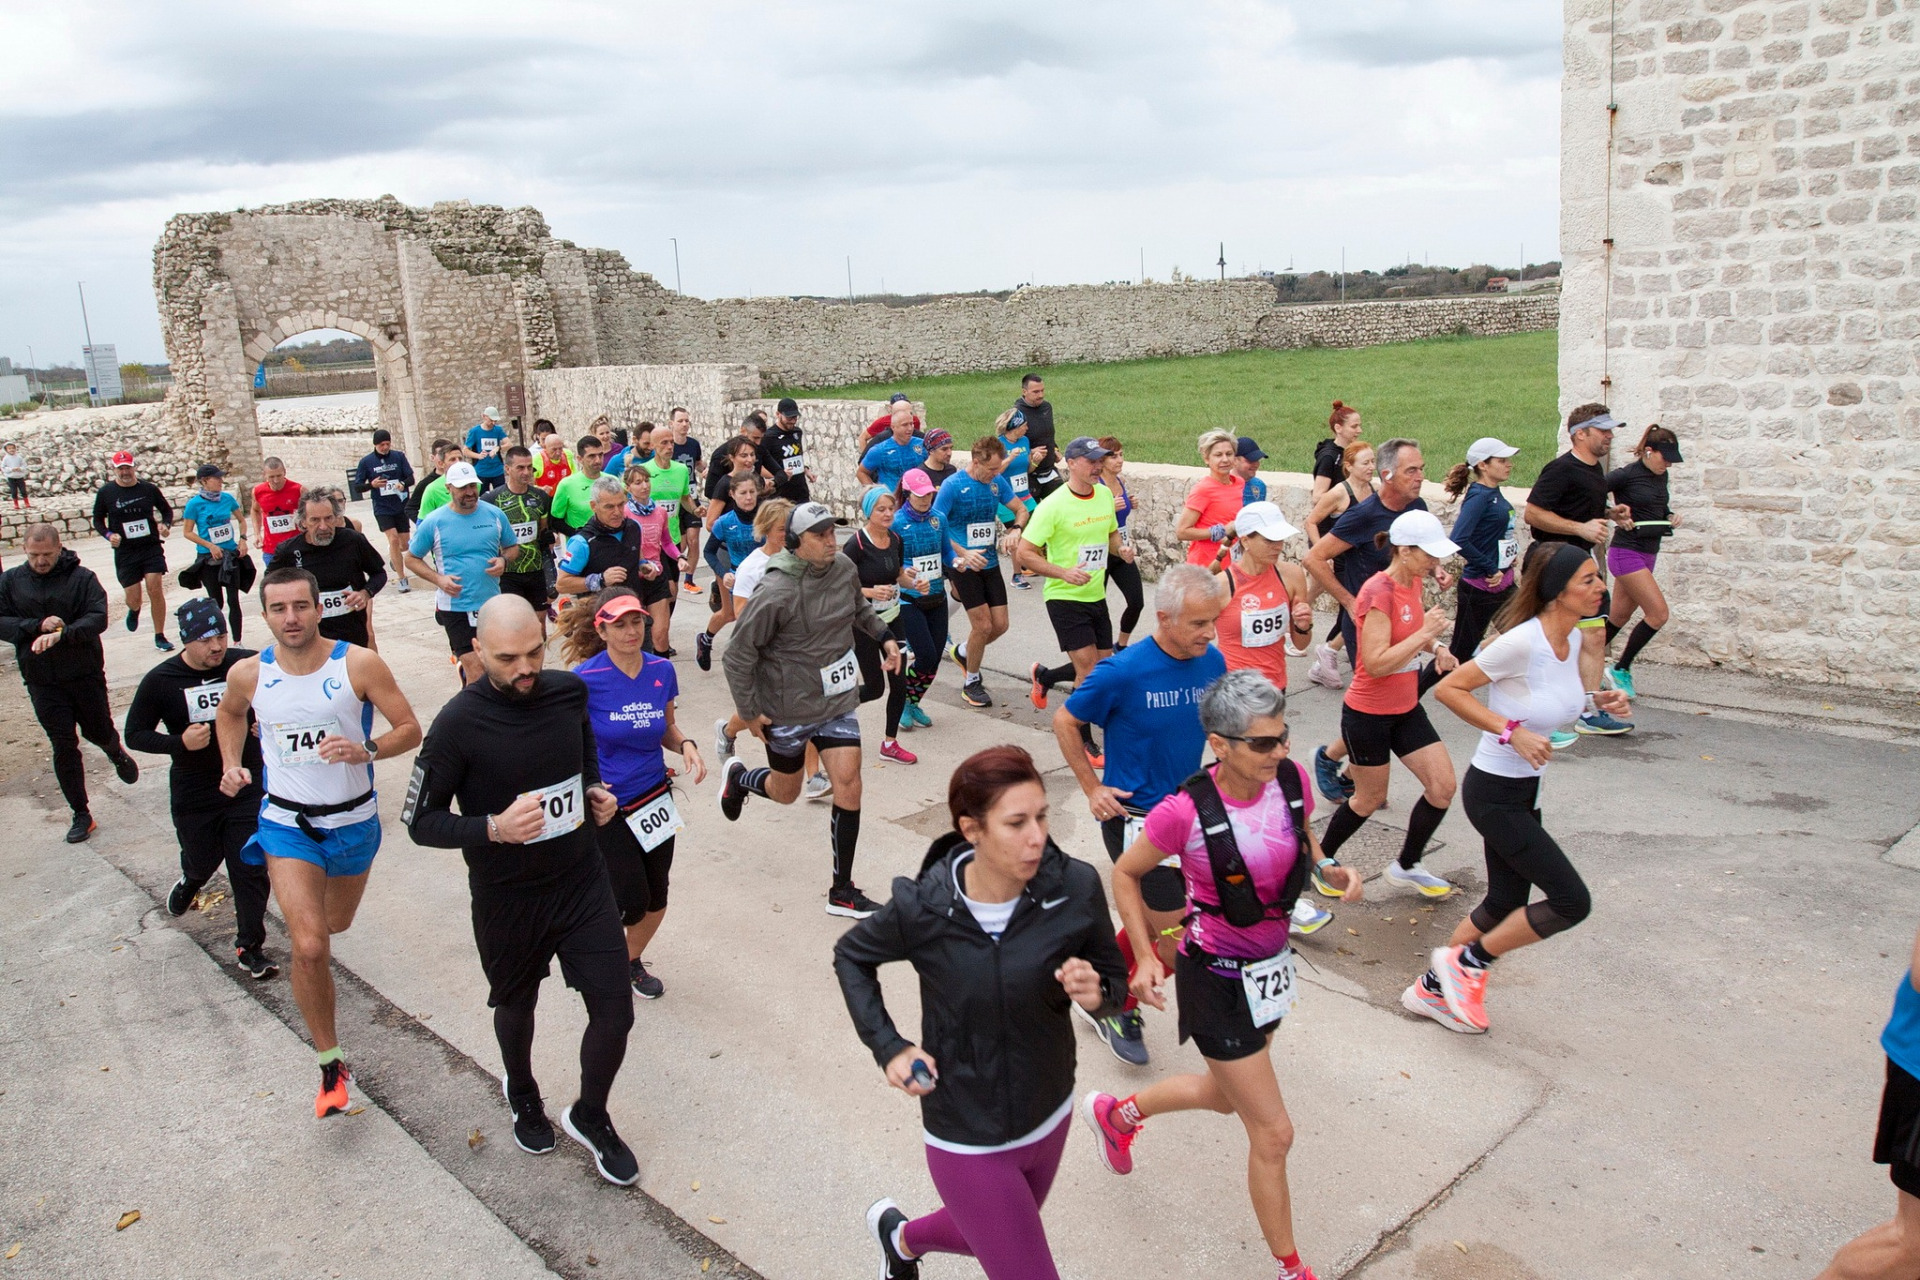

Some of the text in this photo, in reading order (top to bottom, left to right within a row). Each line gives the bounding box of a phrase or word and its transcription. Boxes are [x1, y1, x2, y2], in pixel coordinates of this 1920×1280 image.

[128, 523, 146, 533] 676
[272, 518, 289, 528] 638
[214, 527, 230, 538] 658
[515, 527, 533, 537] 728
[972, 527, 991, 539] 669
[1085, 549, 1104, 562] 727
[920, 559, 939, 572] 721
[1252, 614, 1283, 635] 695
[831, 661, 855, 684] 678
[197, 692, 225, 710] 65
[622, 702, 653, 713] adidas
[609, 709, 664, 722] škola trčanja
[633, 719, 651, 729] 2015
[287, 729, 327, 752] 744
[640, 807, 670, 835] 600
[1256, 965, 1290, 1001] 723
